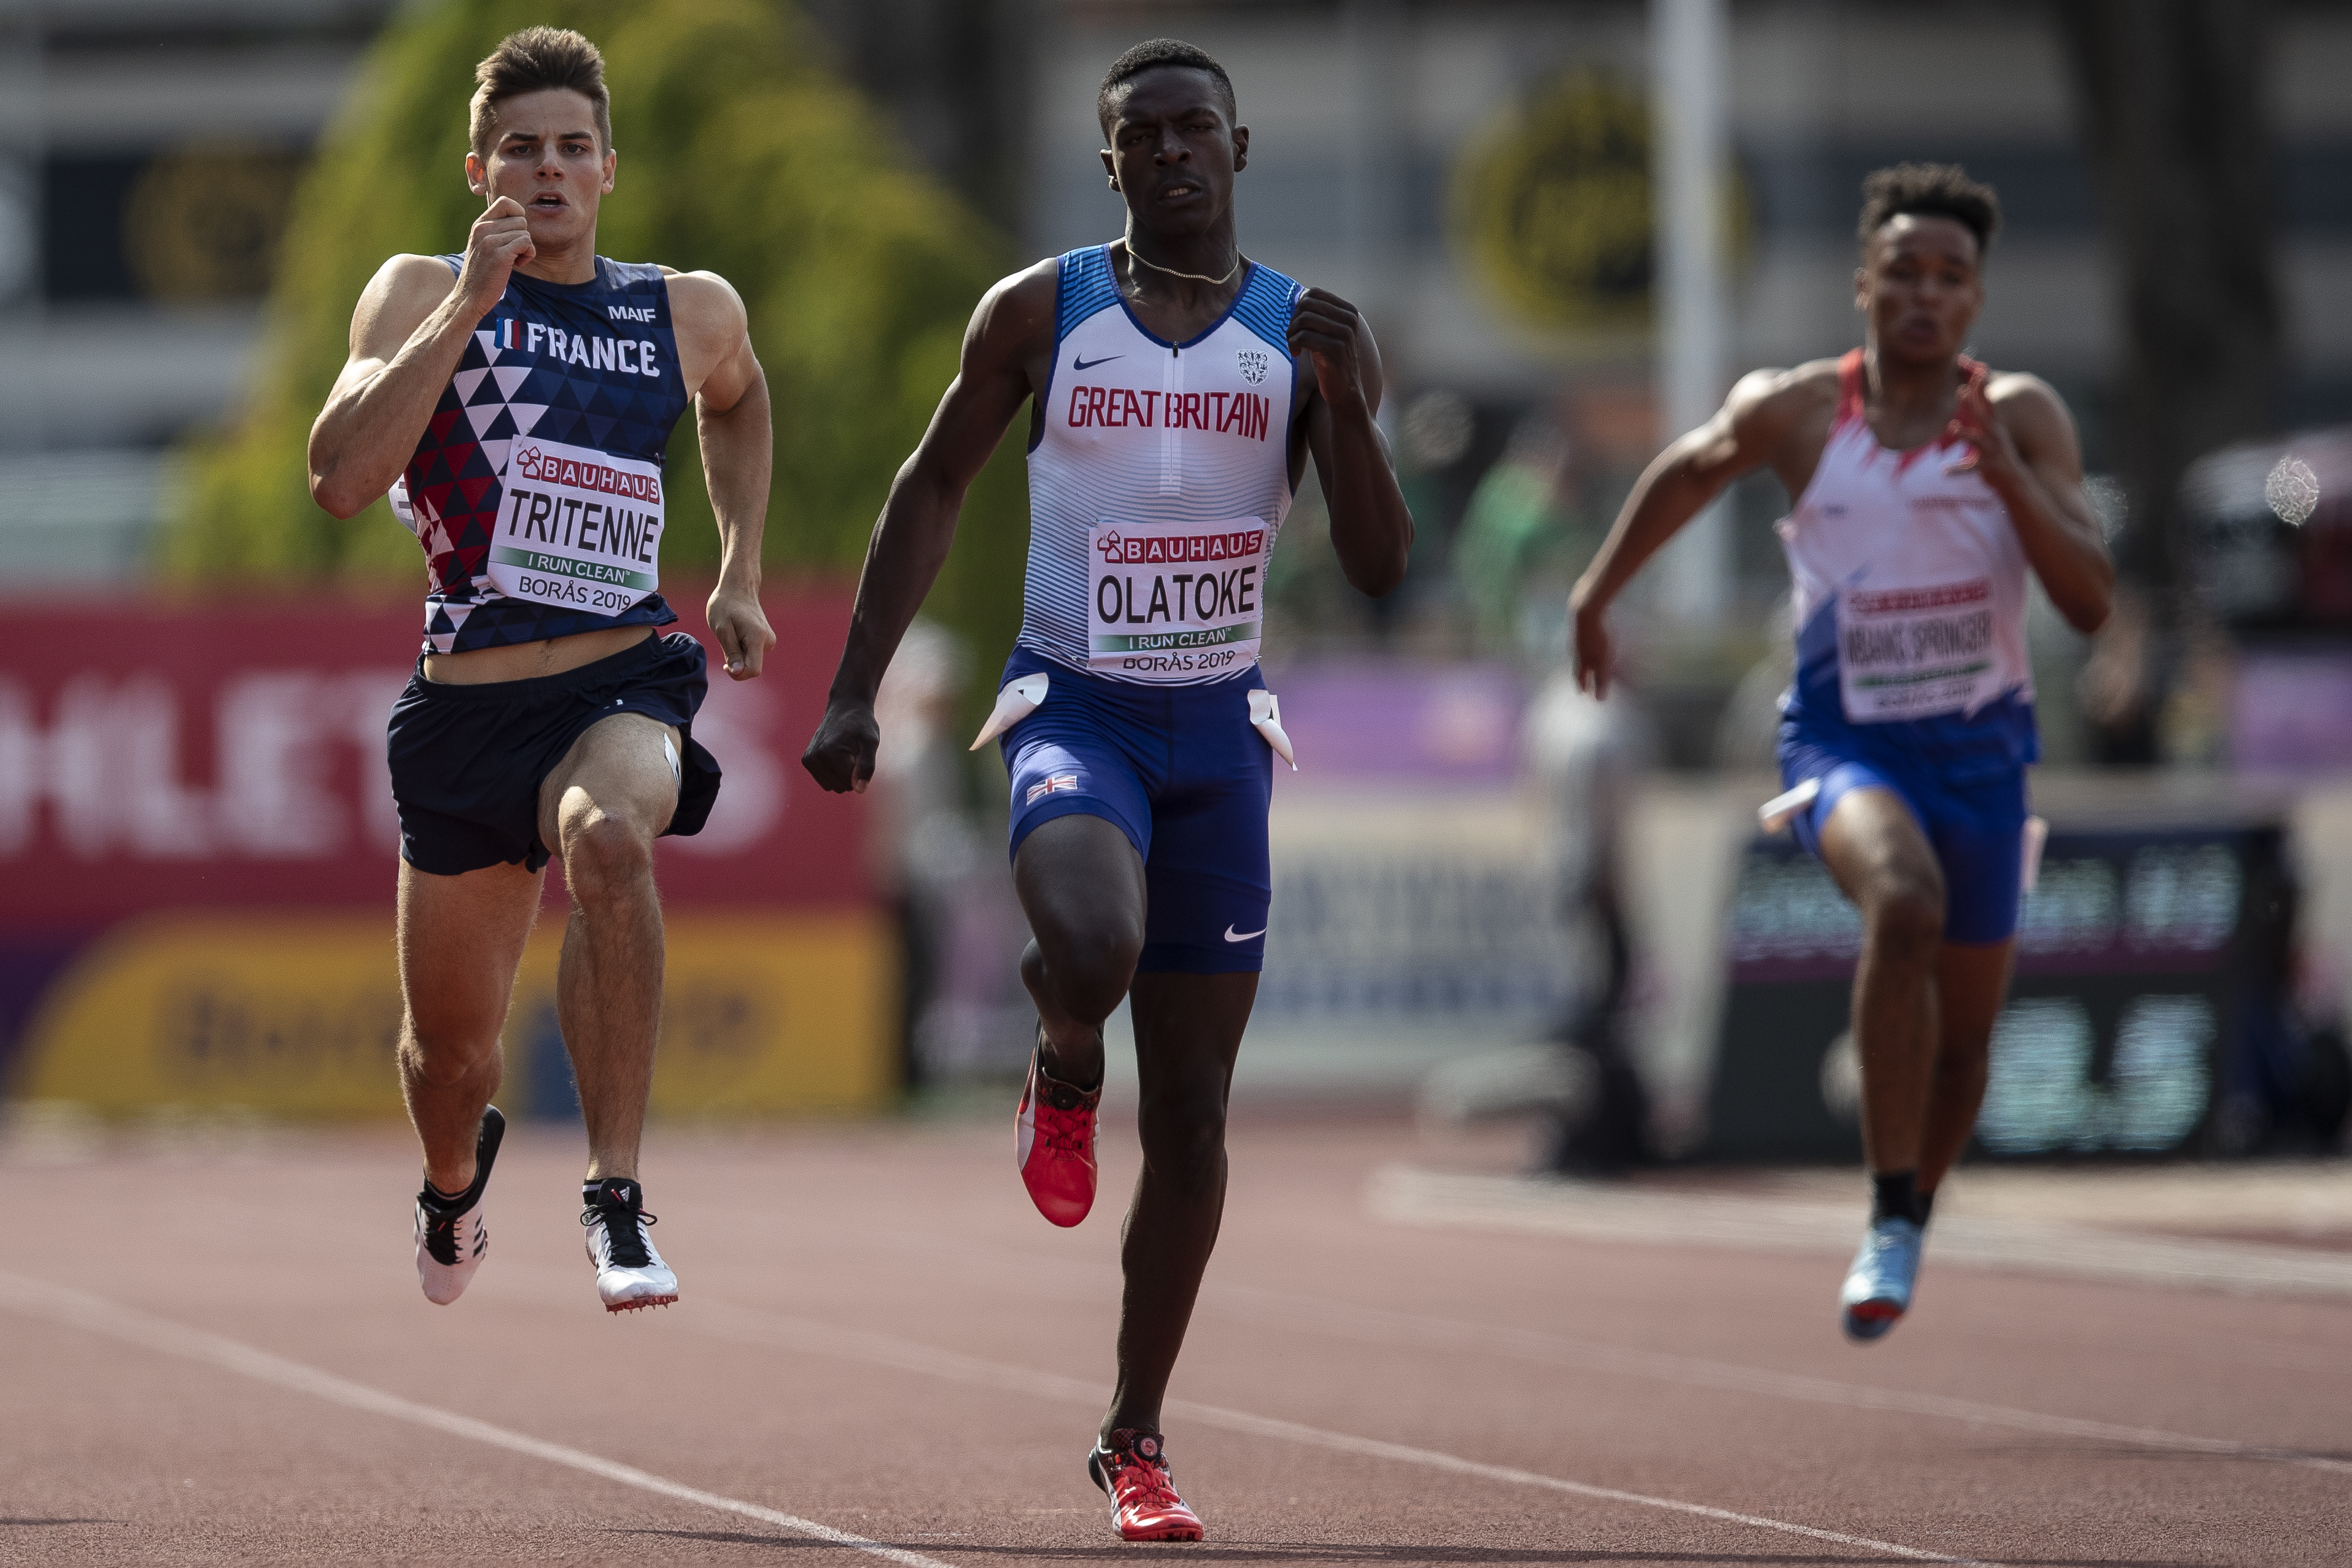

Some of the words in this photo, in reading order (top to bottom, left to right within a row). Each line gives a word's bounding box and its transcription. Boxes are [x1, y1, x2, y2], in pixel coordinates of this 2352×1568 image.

[608, 306, 656, 322] MAIF
[527, 322, 660, 377] FRANCE
[1068, 386, 1162, 427] GREAT
[1164, 392, 1270, 442] BRITAIN
[544, 459, 658, 500] BAUHAUS
[508, 487, 659, 564] TRITENNE
[528, 553, 534, 566] I
[537, 555, 572, 573] RUN
[1127, 532, 1259, 560] BAUHAUS
[519, 575, 588, 604] BORÅS
[591, 589, 631, 611] 2019
[1097, 565, 1257, 624] OLATOKE
[1129, 637, 1133, 649] I
[1138, 635, 1174, 649] RUN
[1123, 651, 1193, 672] BORÅS
[1197, 650, 1236, 670] 2019
